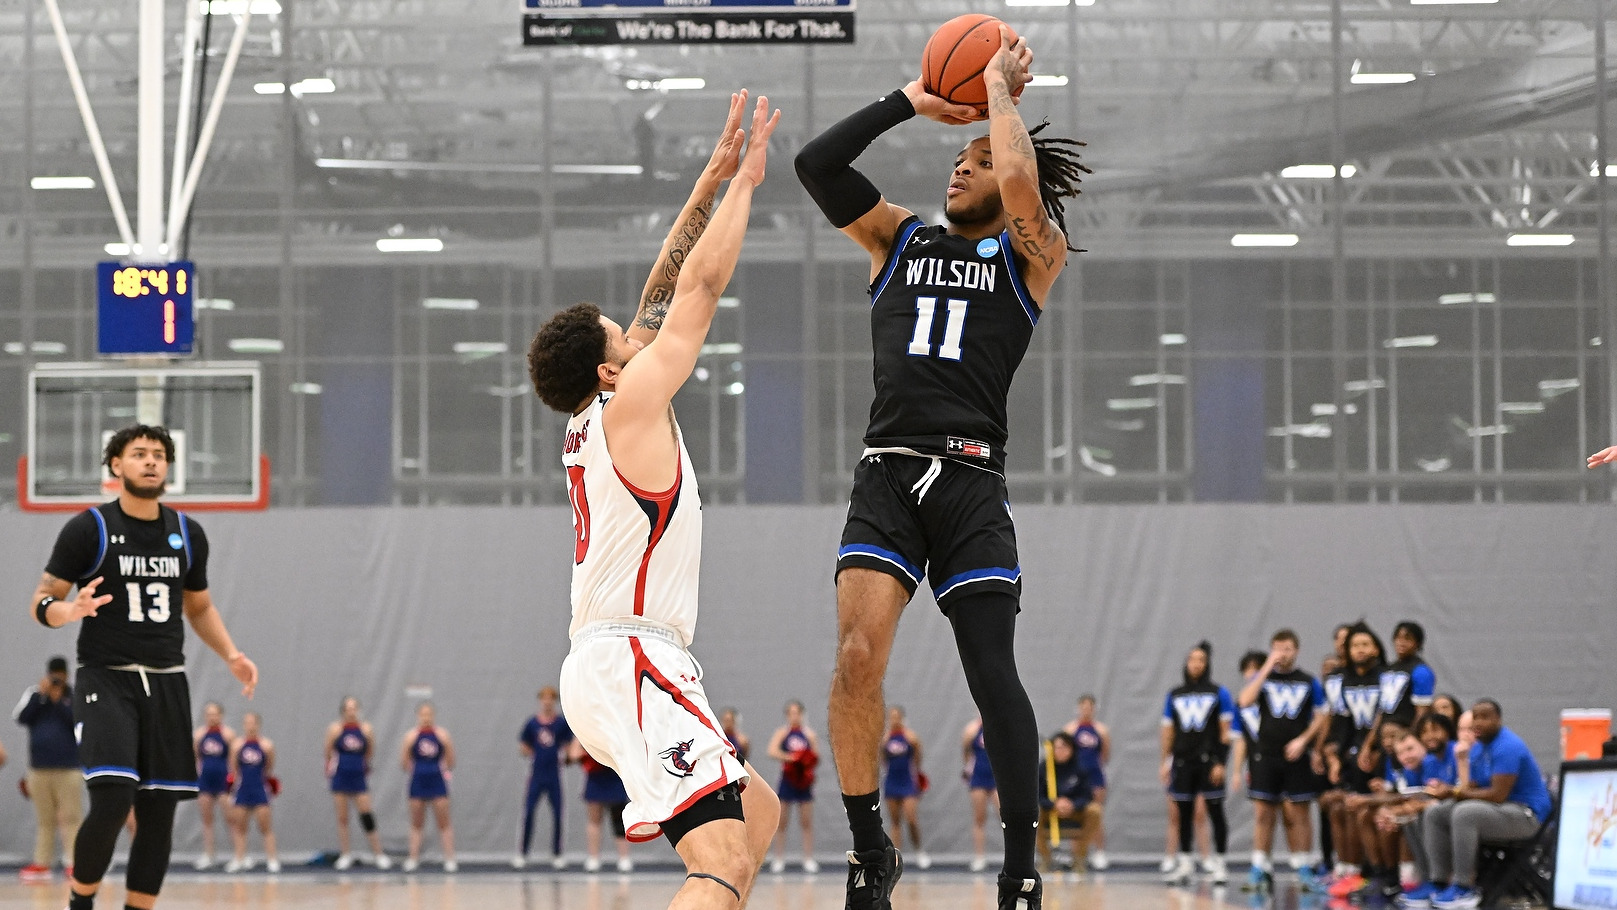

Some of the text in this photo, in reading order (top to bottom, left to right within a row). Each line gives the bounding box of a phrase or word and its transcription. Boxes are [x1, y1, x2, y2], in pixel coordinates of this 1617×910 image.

[615, 20, 675, 40] We're
[676, 20, 713, 39] The
[714, 20, 762, 39] Bank
[764, 20, 798, 39] For
[798, 20, 846, 39] That.
[113, 267, 187, 298] 18:41
[905, 257, 996, 293] WILSON
[163, 299, 175, 344] 1
[906, 296, 970, 362] 11
[118, 555, 180, 578] WILSON
[125, 582, 171, 623] 13
[1172, 693, 1219, 732] W
[1262, 680, 1312, 719] W
[1343, 686, 1381, 729] W
